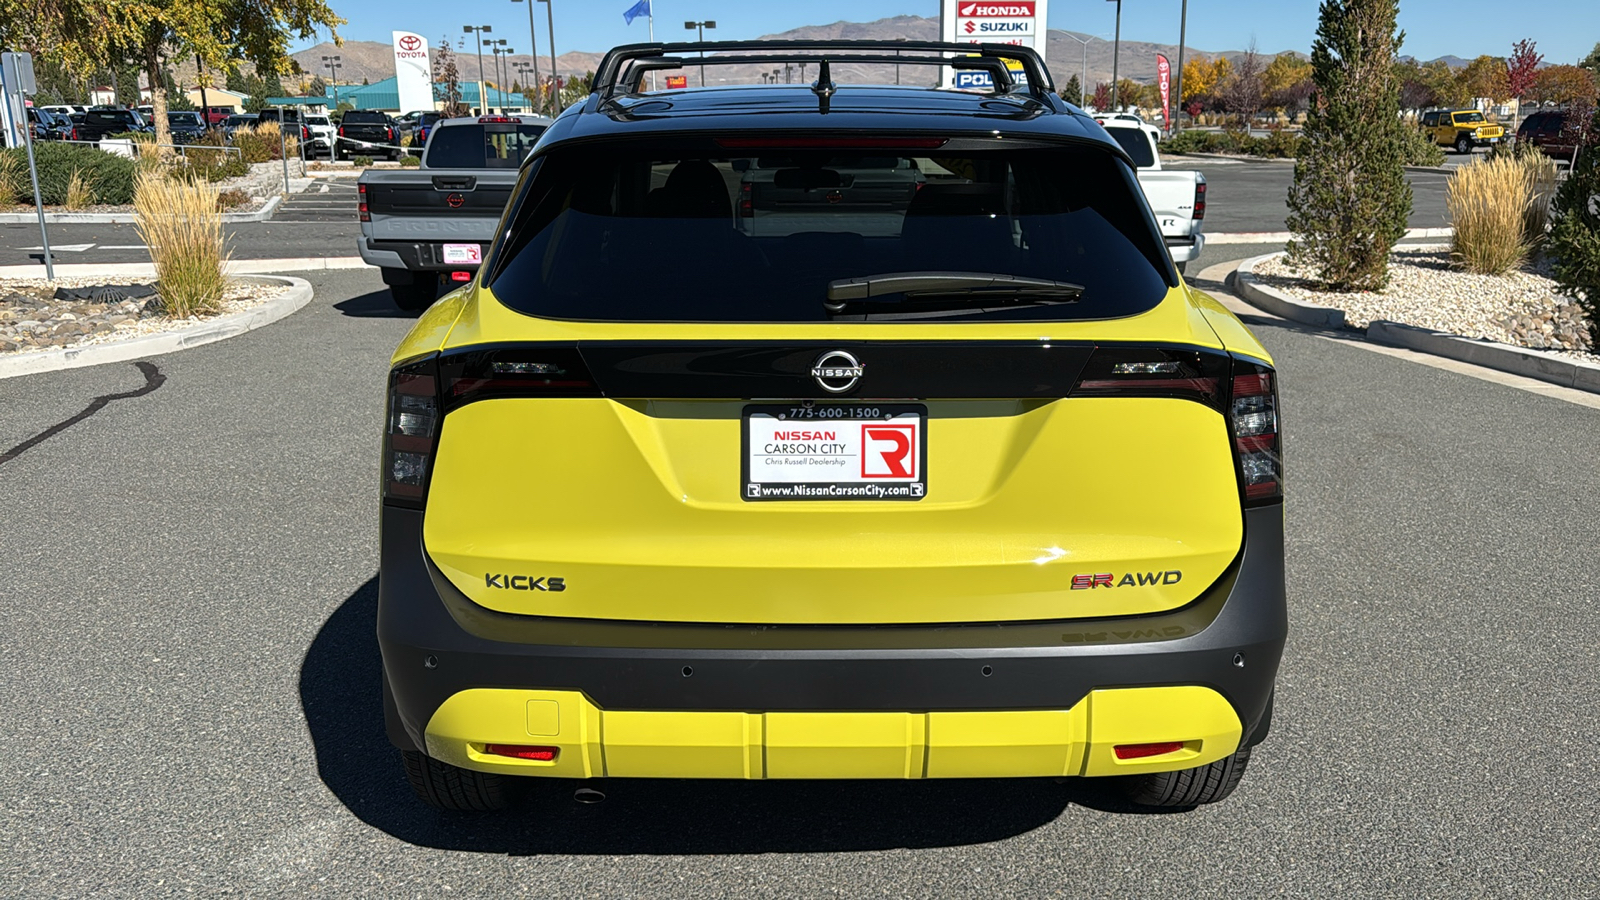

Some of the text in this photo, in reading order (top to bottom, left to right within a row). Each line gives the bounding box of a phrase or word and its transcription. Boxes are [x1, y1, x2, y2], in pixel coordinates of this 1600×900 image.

[976, 7, 1030, 15] HONDA
[980, 22, 1028, 31] SUZUKI
[960, 74, 1028, 86] POLIS
[387, 220, 495, 231] FRONTI
[812, 369, 863, 377] NISSAN
[790, 408, 880, 418] 775-600-1500
[774, 431, 835, 441] NISSAN
[764, 443, 846, 454] CARSON CITY
[765, 457, 846, 467] Chris Russell Dealership
[762, 484, 909, 498] www.NissanCarsonCity.com
[485, 572, 566, 592] KICKS
[1070, 570, 1182, 590] SR AWD
